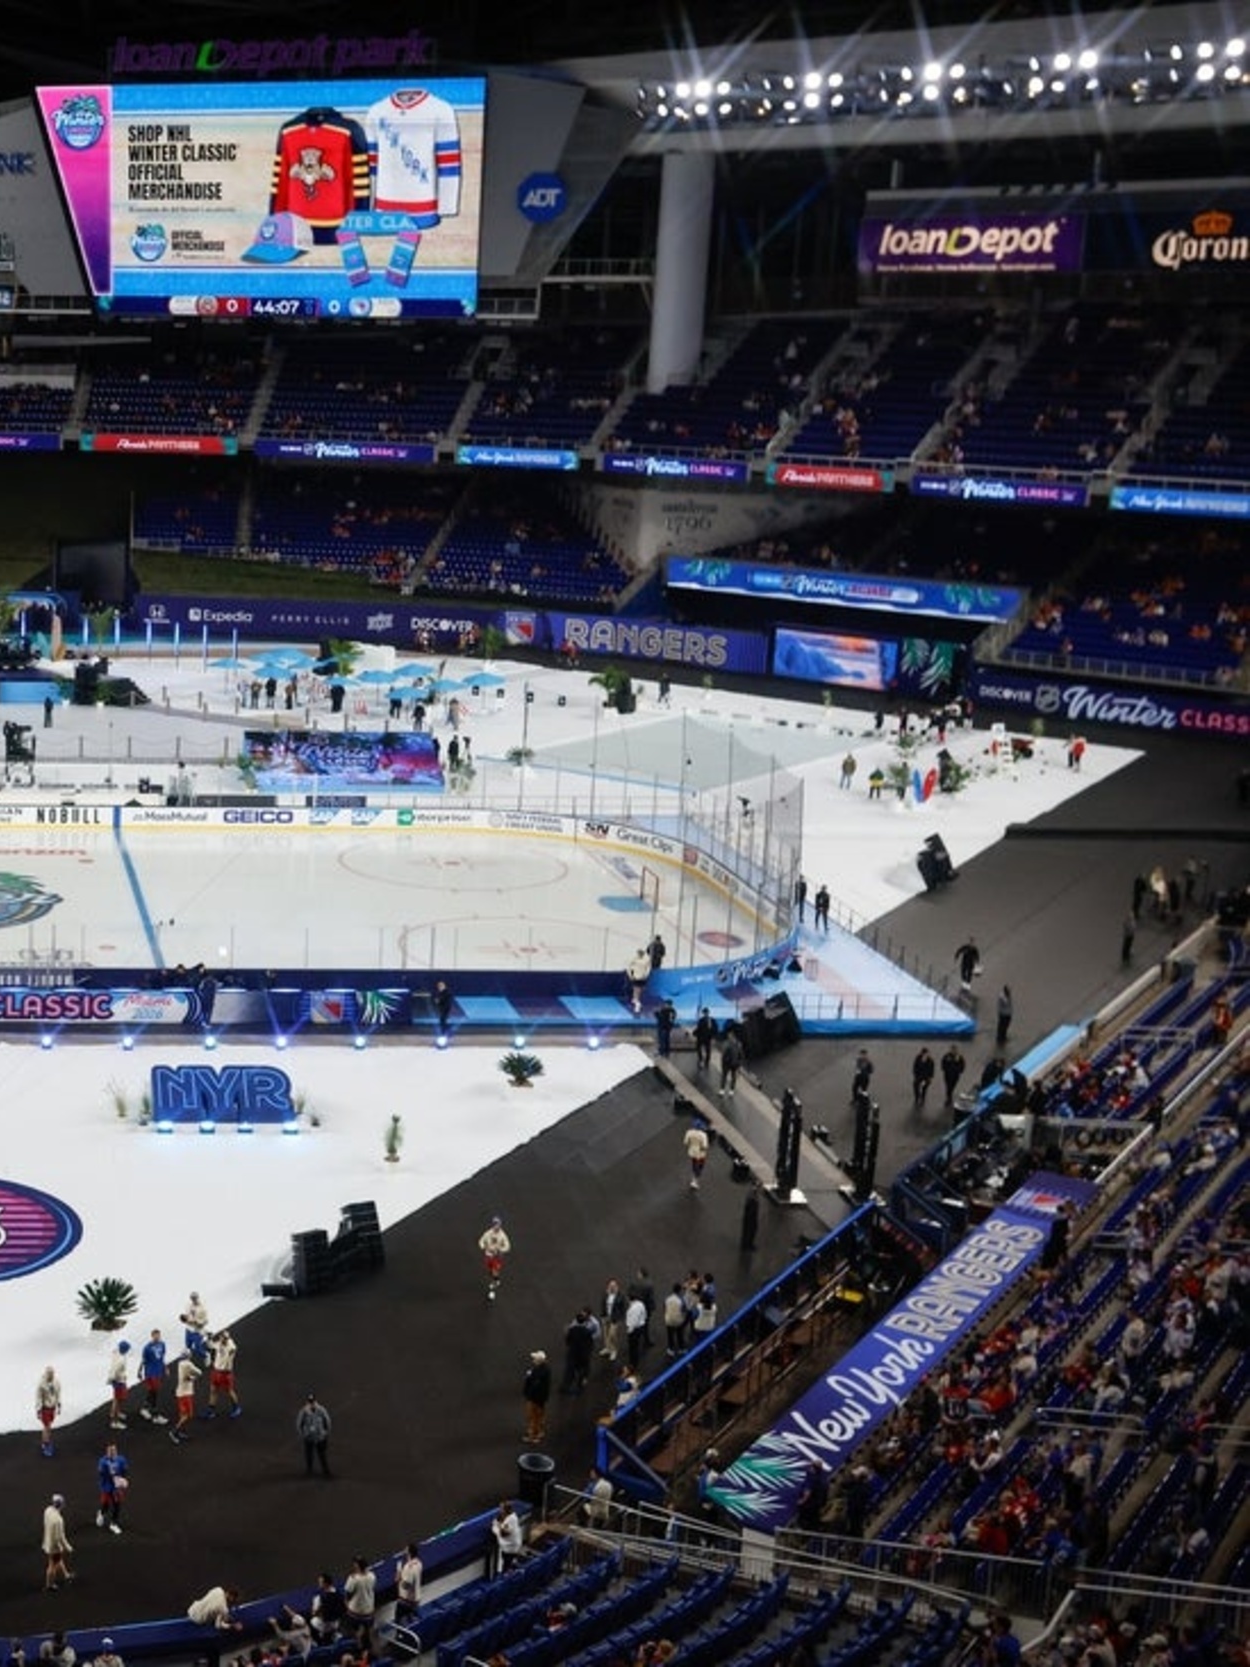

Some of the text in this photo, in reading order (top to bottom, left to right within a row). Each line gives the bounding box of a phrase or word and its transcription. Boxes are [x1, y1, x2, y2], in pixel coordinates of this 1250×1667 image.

[334, 30, 427, 73] park
[128, 125, 192, 142] SHOP NHL
[128, 143, 237, 161] WINTER CLASSIC
[128, 164, 184, 180] OFFICIAL
[128, 182, 222, 200] MERCHANDISE
[522, 188, 562, 207] ADT
[878, 222, 1059, 262] loanDepot
[1152, 229, 1250, 270] Coron
[226, 300, 341, 313] 0 44:07 0
[1017, 486, 1060, 500] CLASSIC
[203, 609, 252, 623] Expedia
[410, 616, 474, 632] DISCOVER
[563, 617, 728, 667] RANGERS
[979, 684, 1032, 703] DISCOVER
[1062, 685, 1177, 730] Winter
[37, 807, 101, 824] NOBULL
[223, 810, 293, 824] GEICO
[155, 1068, 291, 1110] NYR
[783, 1217, 1044, 1471] New York RANGERS
